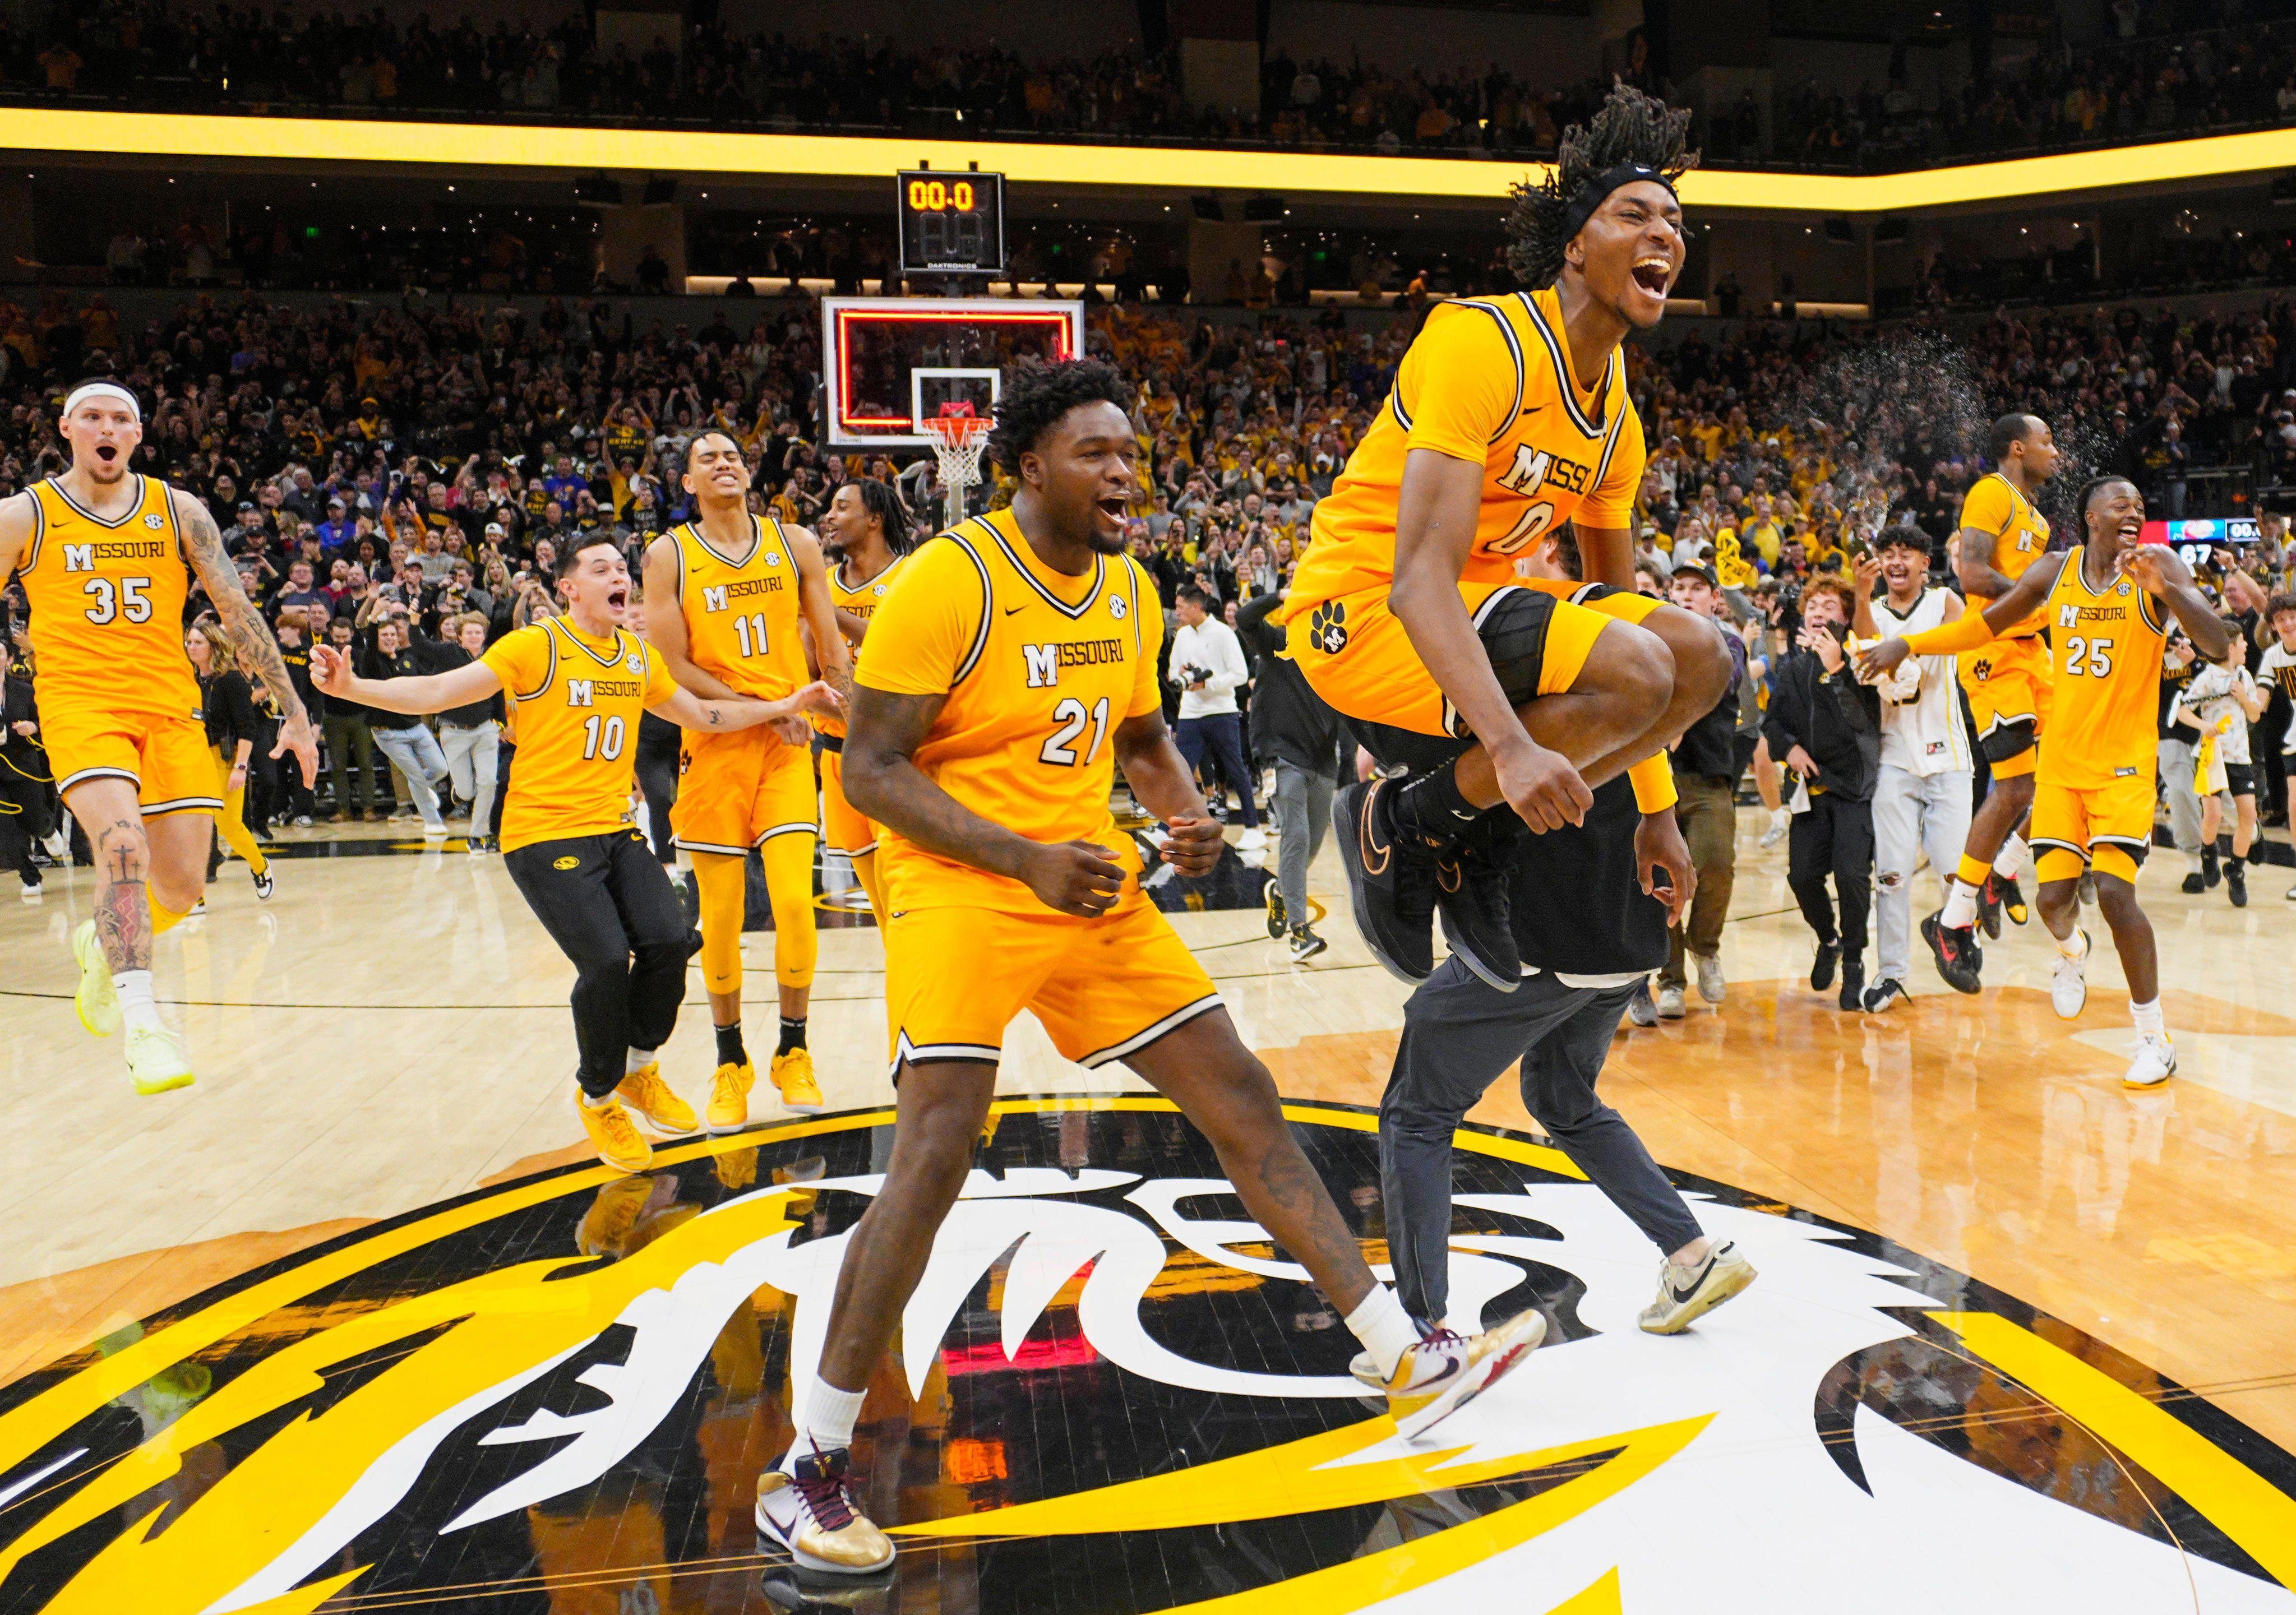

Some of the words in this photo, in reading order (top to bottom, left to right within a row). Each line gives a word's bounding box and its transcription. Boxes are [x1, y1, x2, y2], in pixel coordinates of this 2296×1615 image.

[909, 181, 973, 211] 00.0
[1484, 501, 1554, 556] 0
[63, 542, 165, 572] MISSOURI
[2179, 544, 2212, 565] 67
[84, 577, 153, 625] 35
[702, 576, 783, 613] MISSOURI
[1109, 593, 1127, 620] SEC
[2059, 603, 2127, 628] MISSOURI
[733, 613, 769, 658] 11
[1324, 628, 1346, 652] M
[1022, 638, 1124, 688] MISSOURI
[2066, 635, 2114, 679] 25
[567, 679, 641, 707] MISSOURI
[583, 715, 625, 761] 10
[1038, 697, 1109, 767] 21
